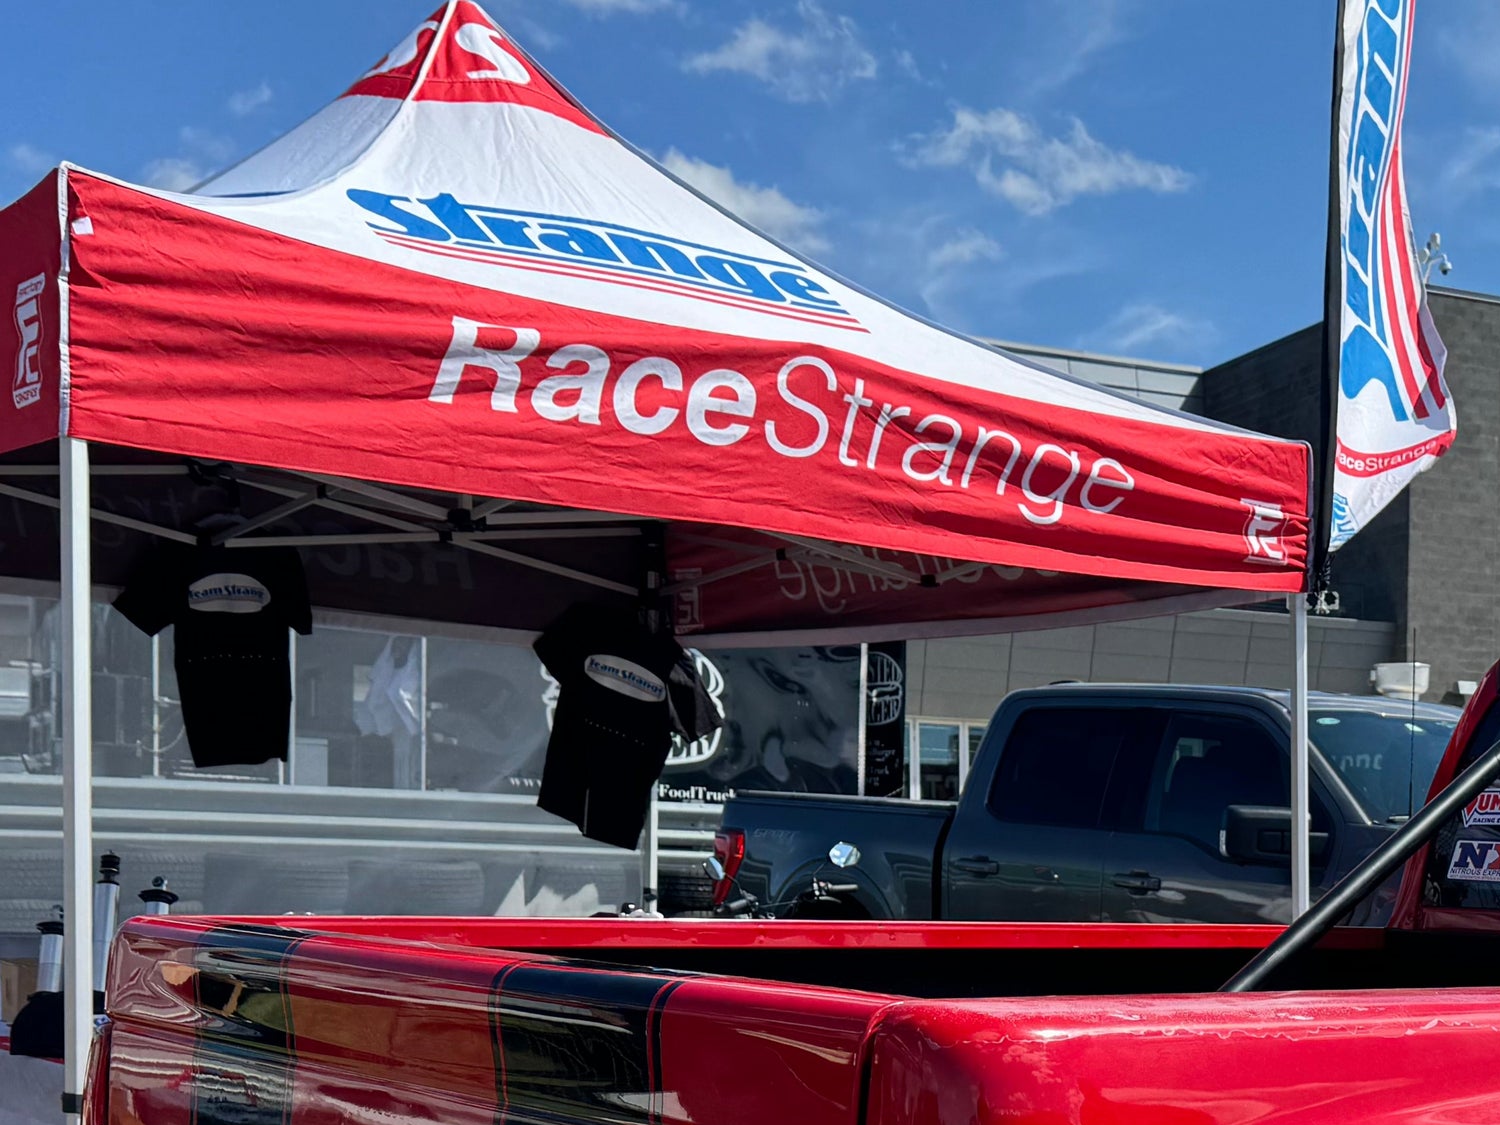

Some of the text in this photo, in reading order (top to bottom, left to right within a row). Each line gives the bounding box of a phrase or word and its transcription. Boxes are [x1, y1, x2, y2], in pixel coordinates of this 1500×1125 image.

[346, 188, 841, 306] Strange
[428, 316, 1134, 523] RaceStrange
[1337, 441, 1437, 471] aceStrange
[1449, 867, 1481, 877] NITROUS
